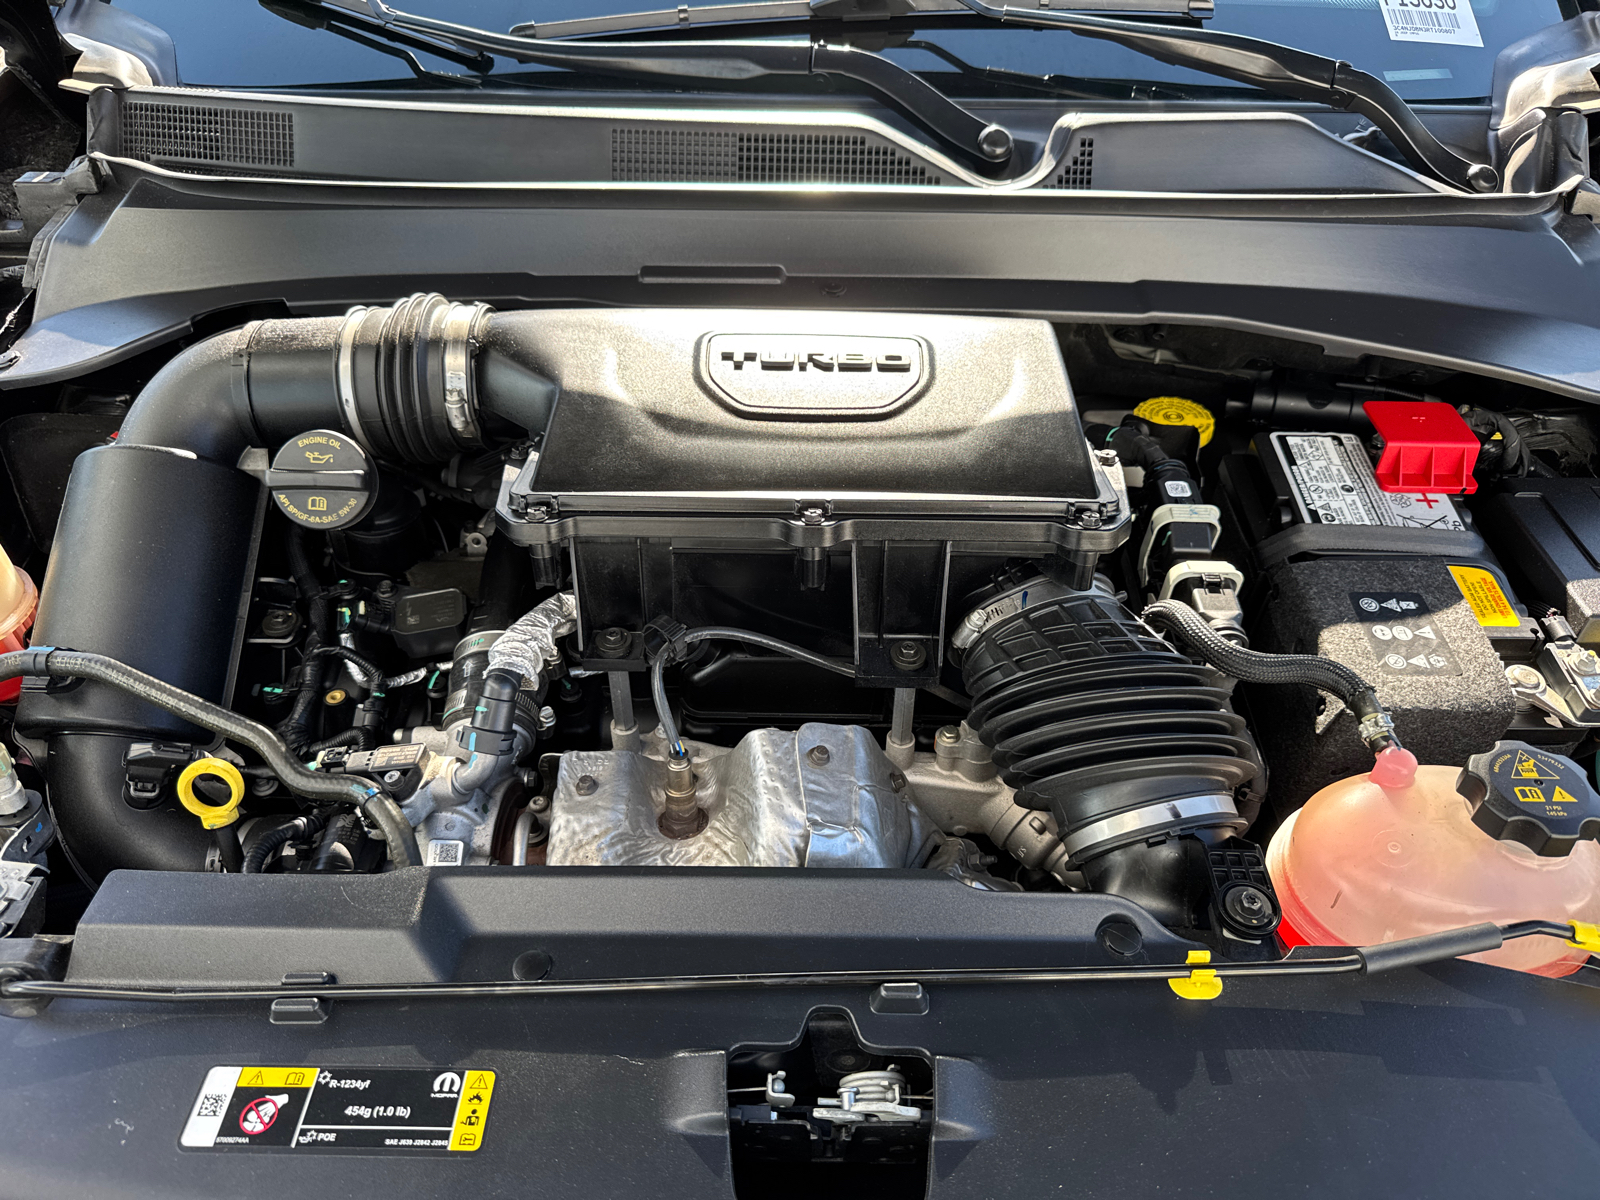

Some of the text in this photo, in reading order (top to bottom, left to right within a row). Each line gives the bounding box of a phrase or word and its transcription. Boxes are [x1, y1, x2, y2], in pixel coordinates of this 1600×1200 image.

[720, 350, 911, 372] TURBO
[298, 436, 341, 450] ENGINE OIL
[278, 494, 290, 506] API
[338, 498, 358, 517] 5W-30
[328, 1080, 371, 1090] R-1234yf
[344, 1106, 411, 1119] 454g (1.0 lb)
[317, 1132, 337, 1141] POE
